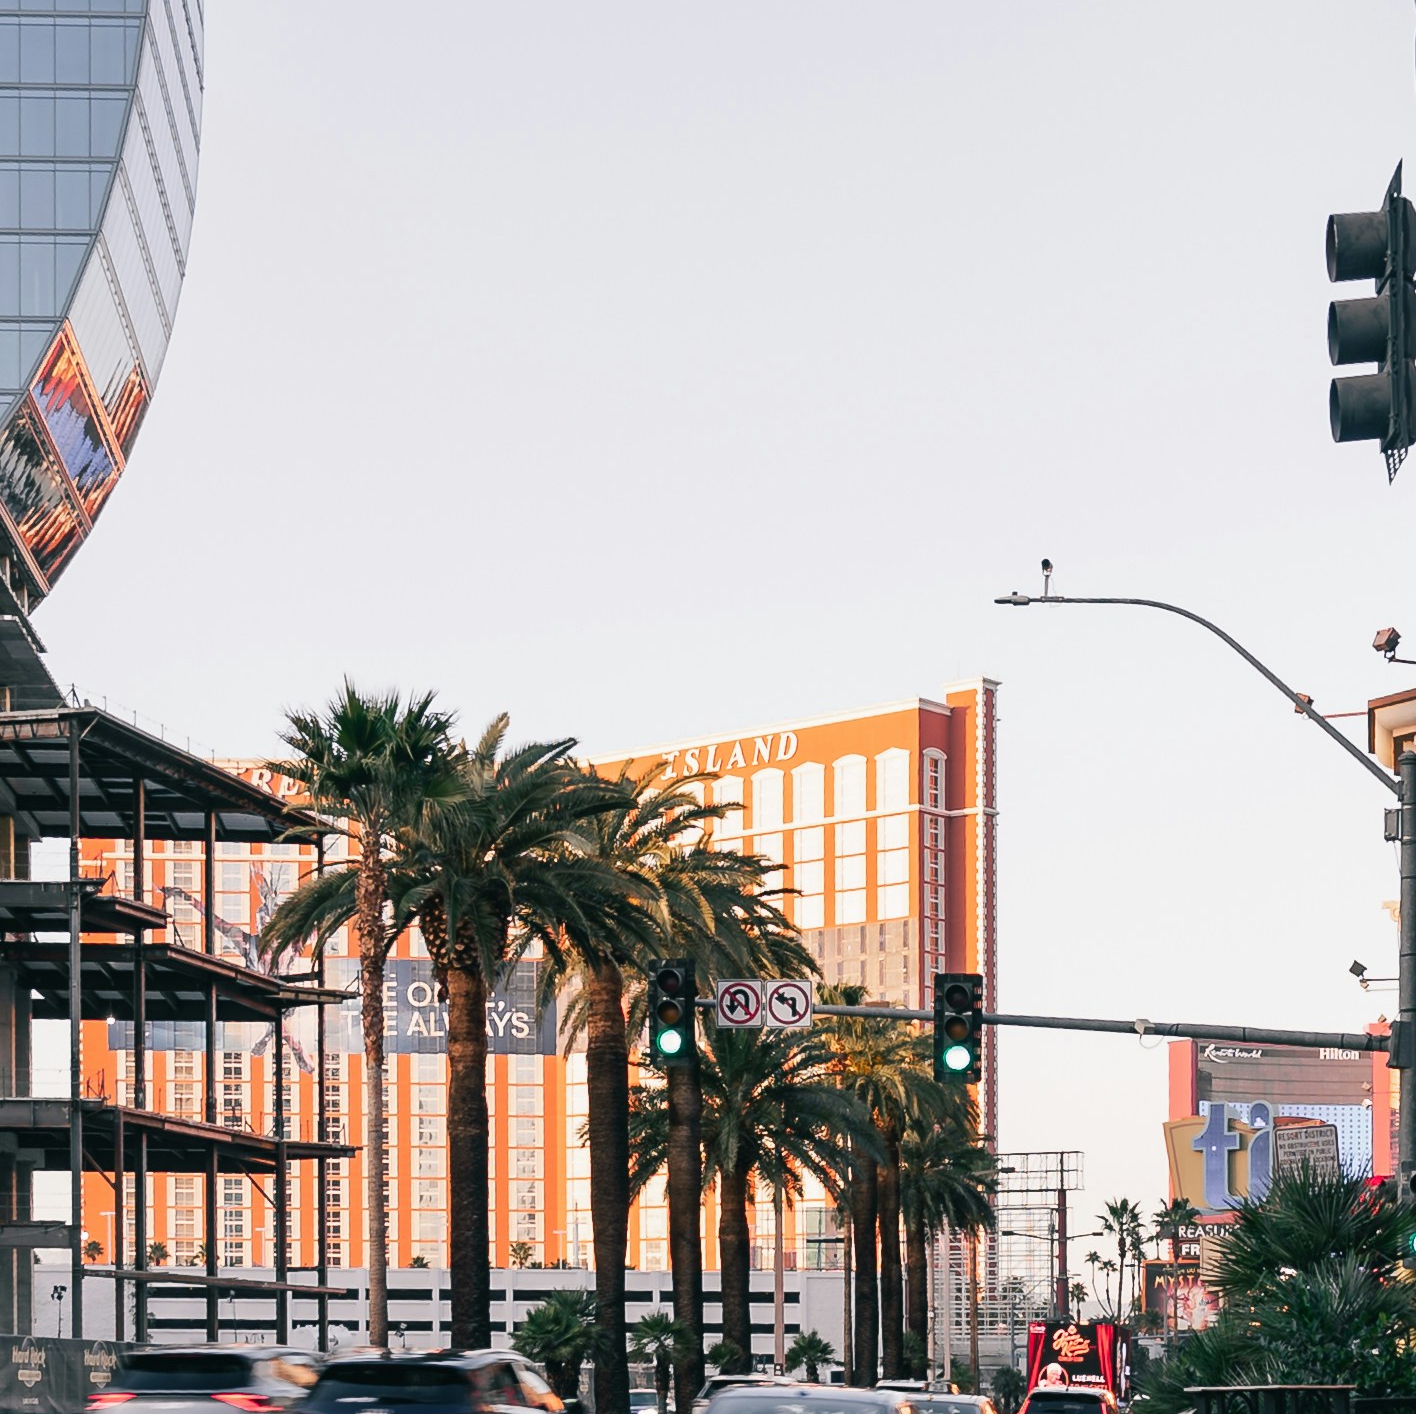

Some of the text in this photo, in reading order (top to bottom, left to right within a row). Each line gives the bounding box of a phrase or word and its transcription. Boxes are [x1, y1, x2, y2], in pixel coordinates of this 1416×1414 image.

[660, 731, 798, 781] ISLAND
[1318, 1048, 1360, 1061] Hilton
[1304, 1129, 1334, 1139] DISTRICT
[1192, 1100, 1274, 1211] ti
[1181, 1243, 1200, 1256] FR
